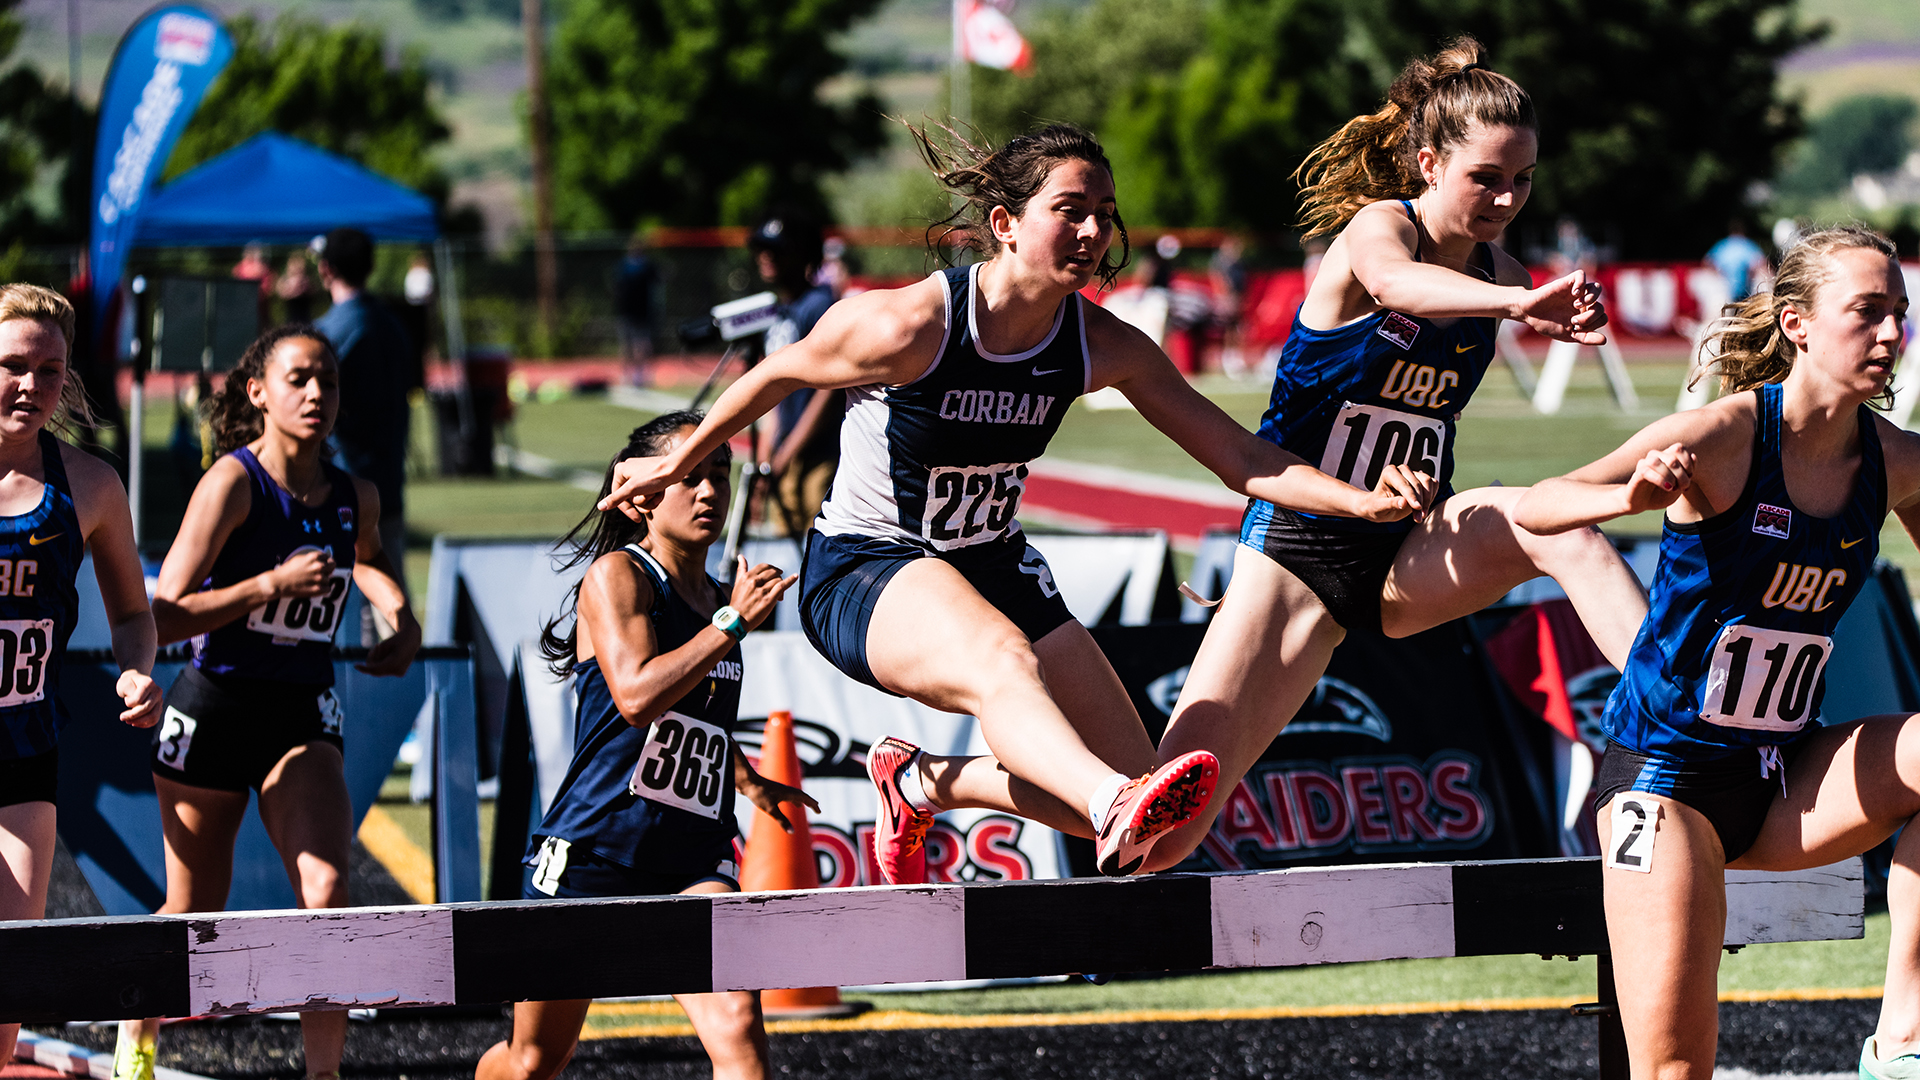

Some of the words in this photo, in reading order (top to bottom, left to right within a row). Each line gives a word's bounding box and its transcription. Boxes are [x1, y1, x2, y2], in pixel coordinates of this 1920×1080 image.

[939, 389, 1055, 426] CORBAN
[1380, 359, 1459, 409] UBC
[1336, 412, 1440, 492] 106
[930, 467, 1022, 541] 225
[1758, 503, 1791, 517] CASCADE
[1761, 562, 1847, 612] UBC
[1720, 635, 1824, 722] 110
[163, 716, 185, 763] 3
[641, 718, 726, 807] 363
[1615, 800, 1647, 867] 2
